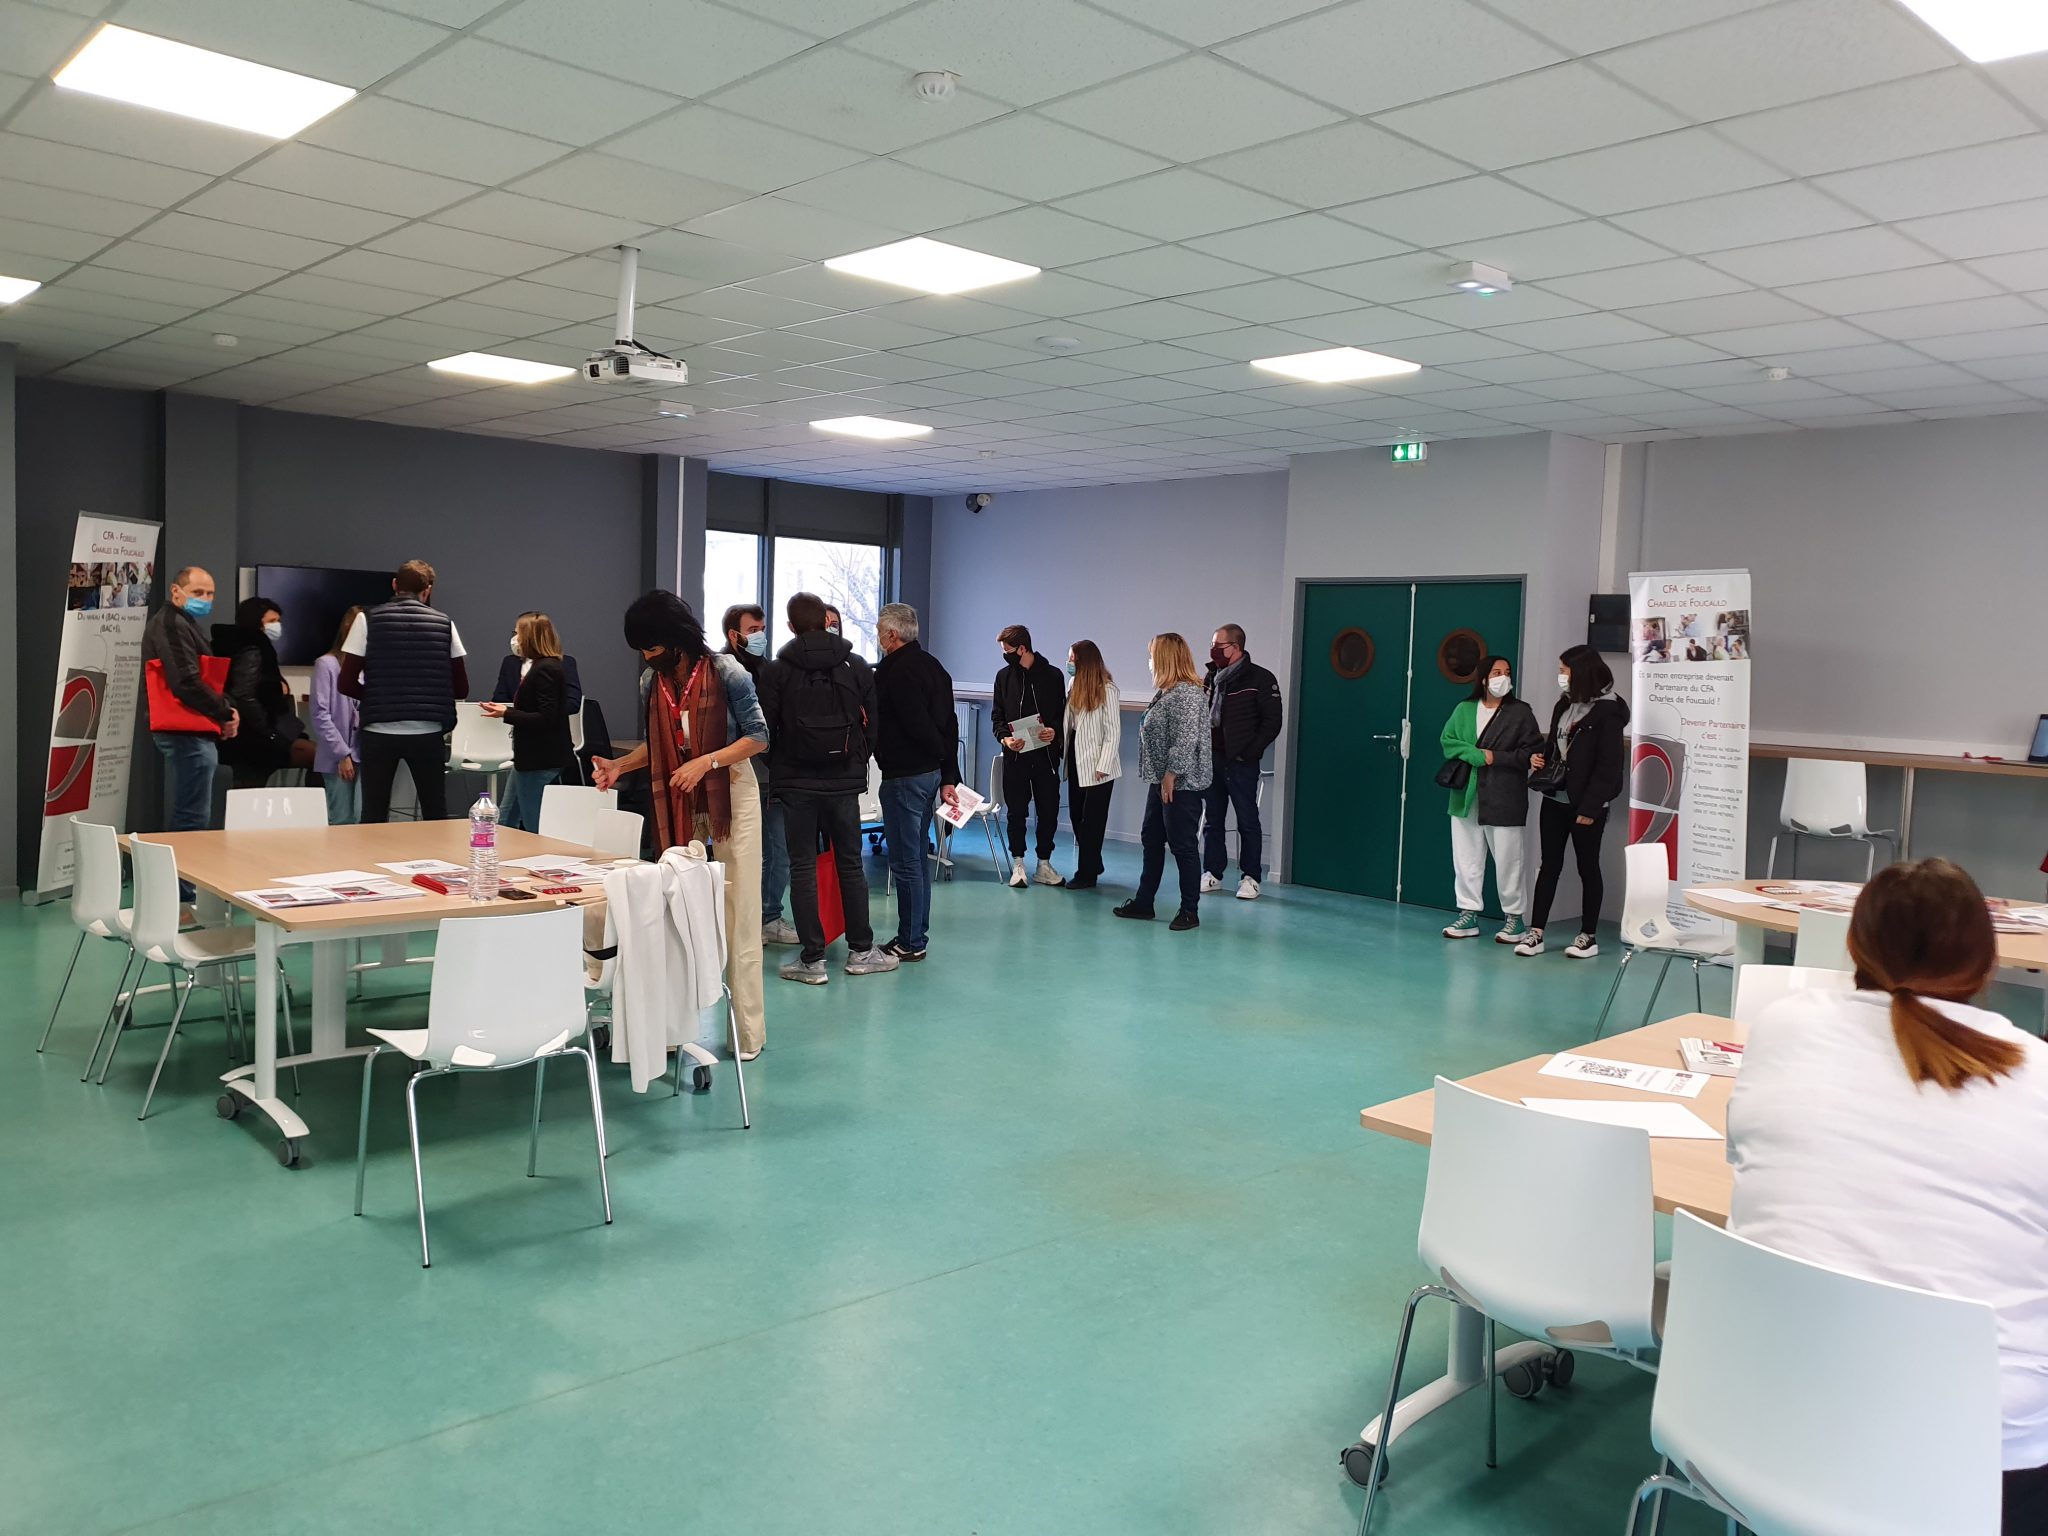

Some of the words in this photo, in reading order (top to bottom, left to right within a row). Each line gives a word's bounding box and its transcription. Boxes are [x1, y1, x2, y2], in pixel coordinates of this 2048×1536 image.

[102, 530, 115, 541] CFA
[1662, 584, 1679, 594] CFA
[1647, 598, 1677, 608] CHARLES
[1689, 598, 1728, 607] FOUCAULD
[1670, 672, 1704, 682] entreprise
[1705, 672, 1734, 682] devenait
[1654, 683, 1688, 692] Partenaire
[1689, 684, 1698, 693] du
[1700, 684, 1715, 693] CFA
[1648, 693, 1674, 704] Charles
[1675, 695, 1684, 704] de
[1685, 696, 1715, 705] Foucauld
[1680, 717, 1707, 727] Devenir
[1708, 719, 1747, 730] Partenaire
